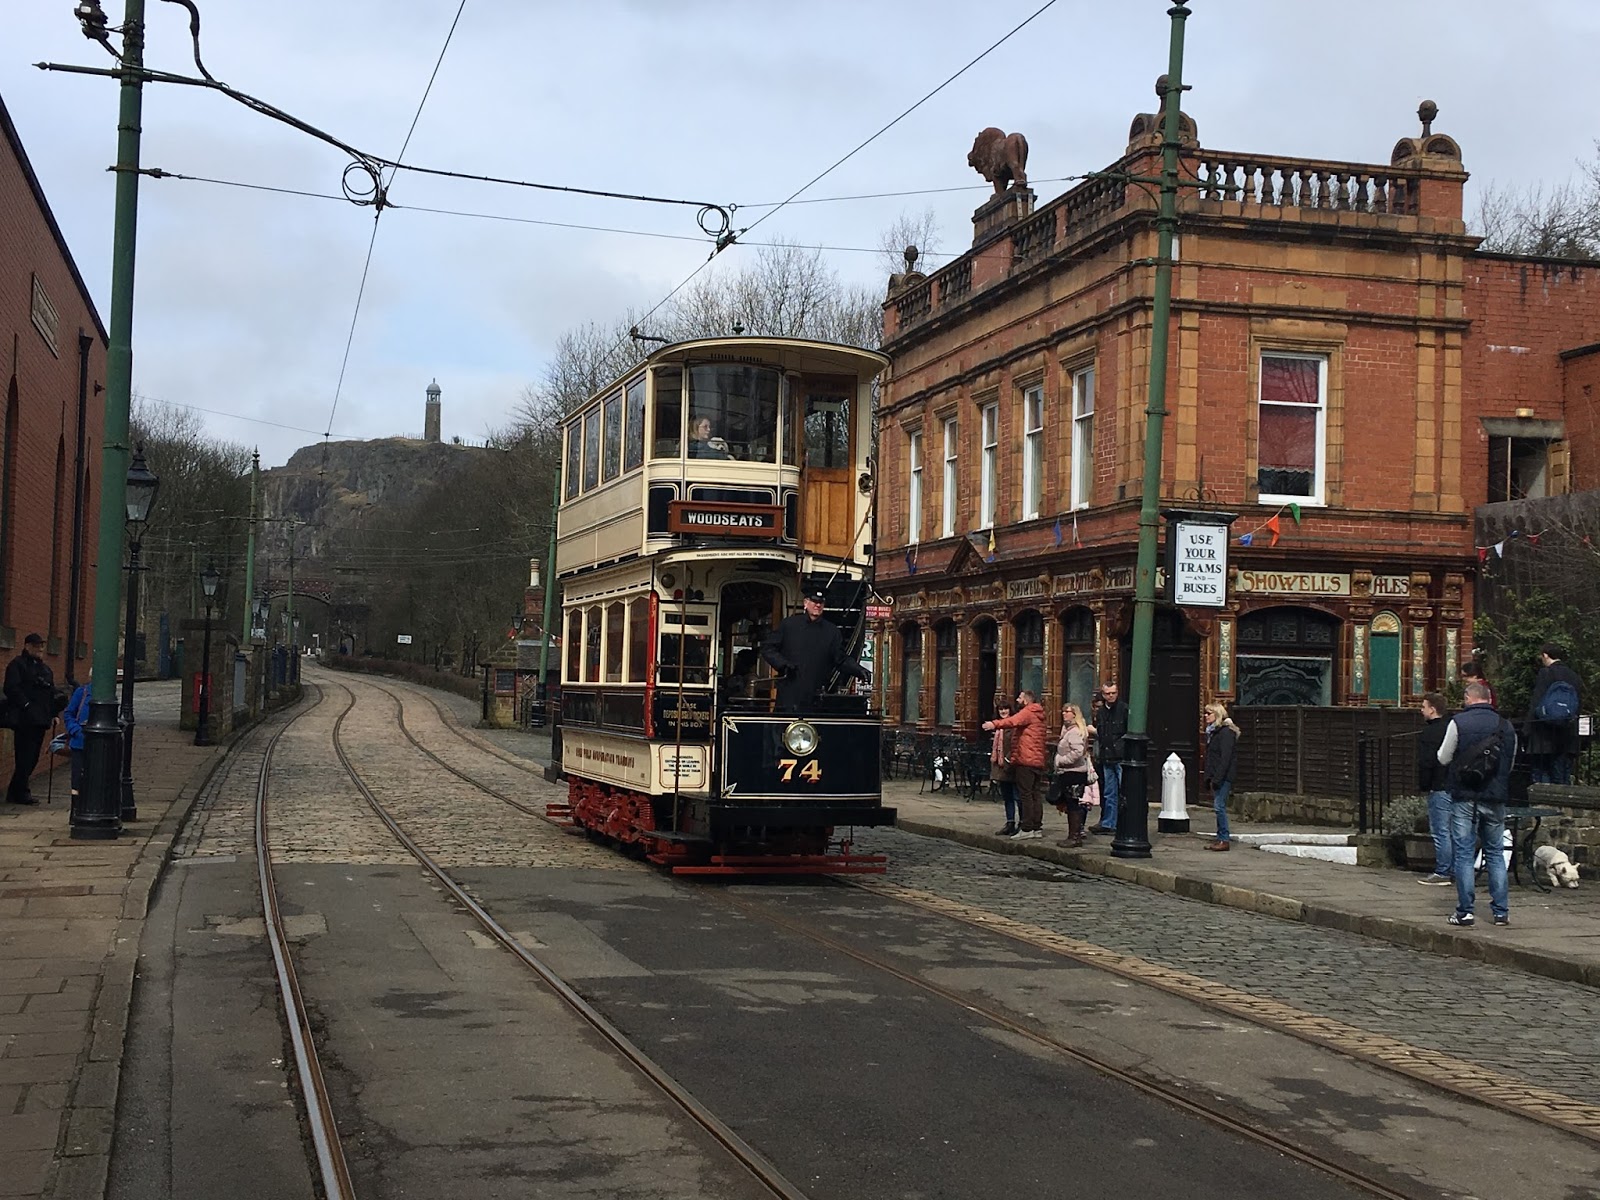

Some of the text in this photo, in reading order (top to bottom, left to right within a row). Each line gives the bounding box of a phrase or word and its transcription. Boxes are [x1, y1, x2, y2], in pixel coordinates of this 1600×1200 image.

[688, 512, 763, 527] WOODSEATS
[1189, 534, 1214, 545] USE
[1184, 547, 1216, 559] YOUR
[1178, 562, 1222, 574] TRAMS
[1182, 582, 1217, 594] BUSES
[1369, 574, 1409, 597] ALES
[1256, 680, 1279, 692] RED
[777, 758, 822, 784] 74
